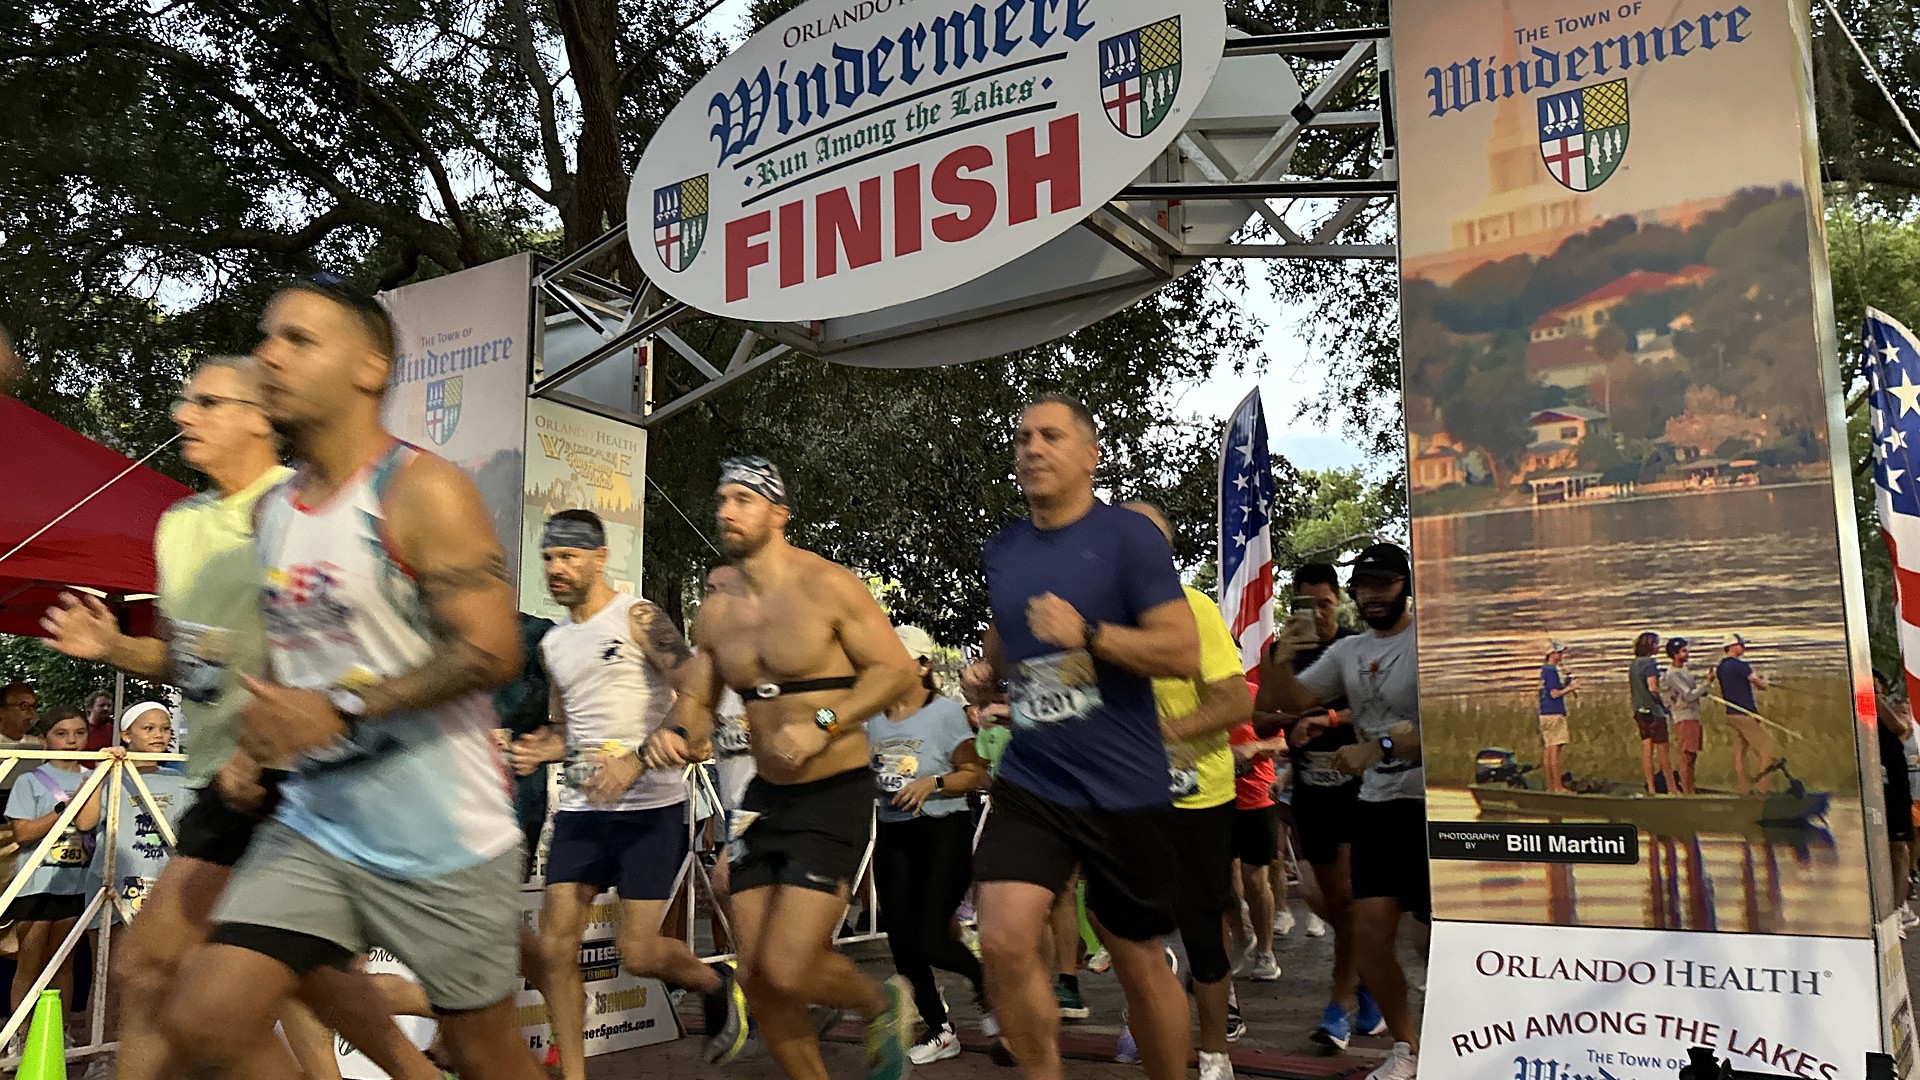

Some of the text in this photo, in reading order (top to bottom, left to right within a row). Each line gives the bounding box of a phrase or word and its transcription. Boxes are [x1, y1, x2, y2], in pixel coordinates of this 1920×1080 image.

[783, 0, 892, 48] ORLANDO
[1515, 2, 1642, 46] THE TOWN OF
[1424, 4, 1752, 118] Windermere
[708, 0, 1096, 168] Windermere
[756, 75, 1034, 190] Run Among the Lakes
[724, 113, 1082, 304] FINISH
[421, 328, 473, 347] THE TOWN OF
[535, 415, 637, 452] ORLANDO HEALTH
[60, 848, 82, 860] 363
[1438, 831, 1500, 843] PHOTOGRAPHY
[1464, 841, 1476, 850] BY
[1506, 833, 1626, 856] Bill Martini
[1475, 950, 1656, 985] ORLANDO
[529, 1035, 543, 1049] FL
[1452, 1010, 1839, 1080] RUN AMONG THE LAKES
[1587, 1049, 1614, 1065] THE
[1618, 1051, 1661, 1070] TOWN
